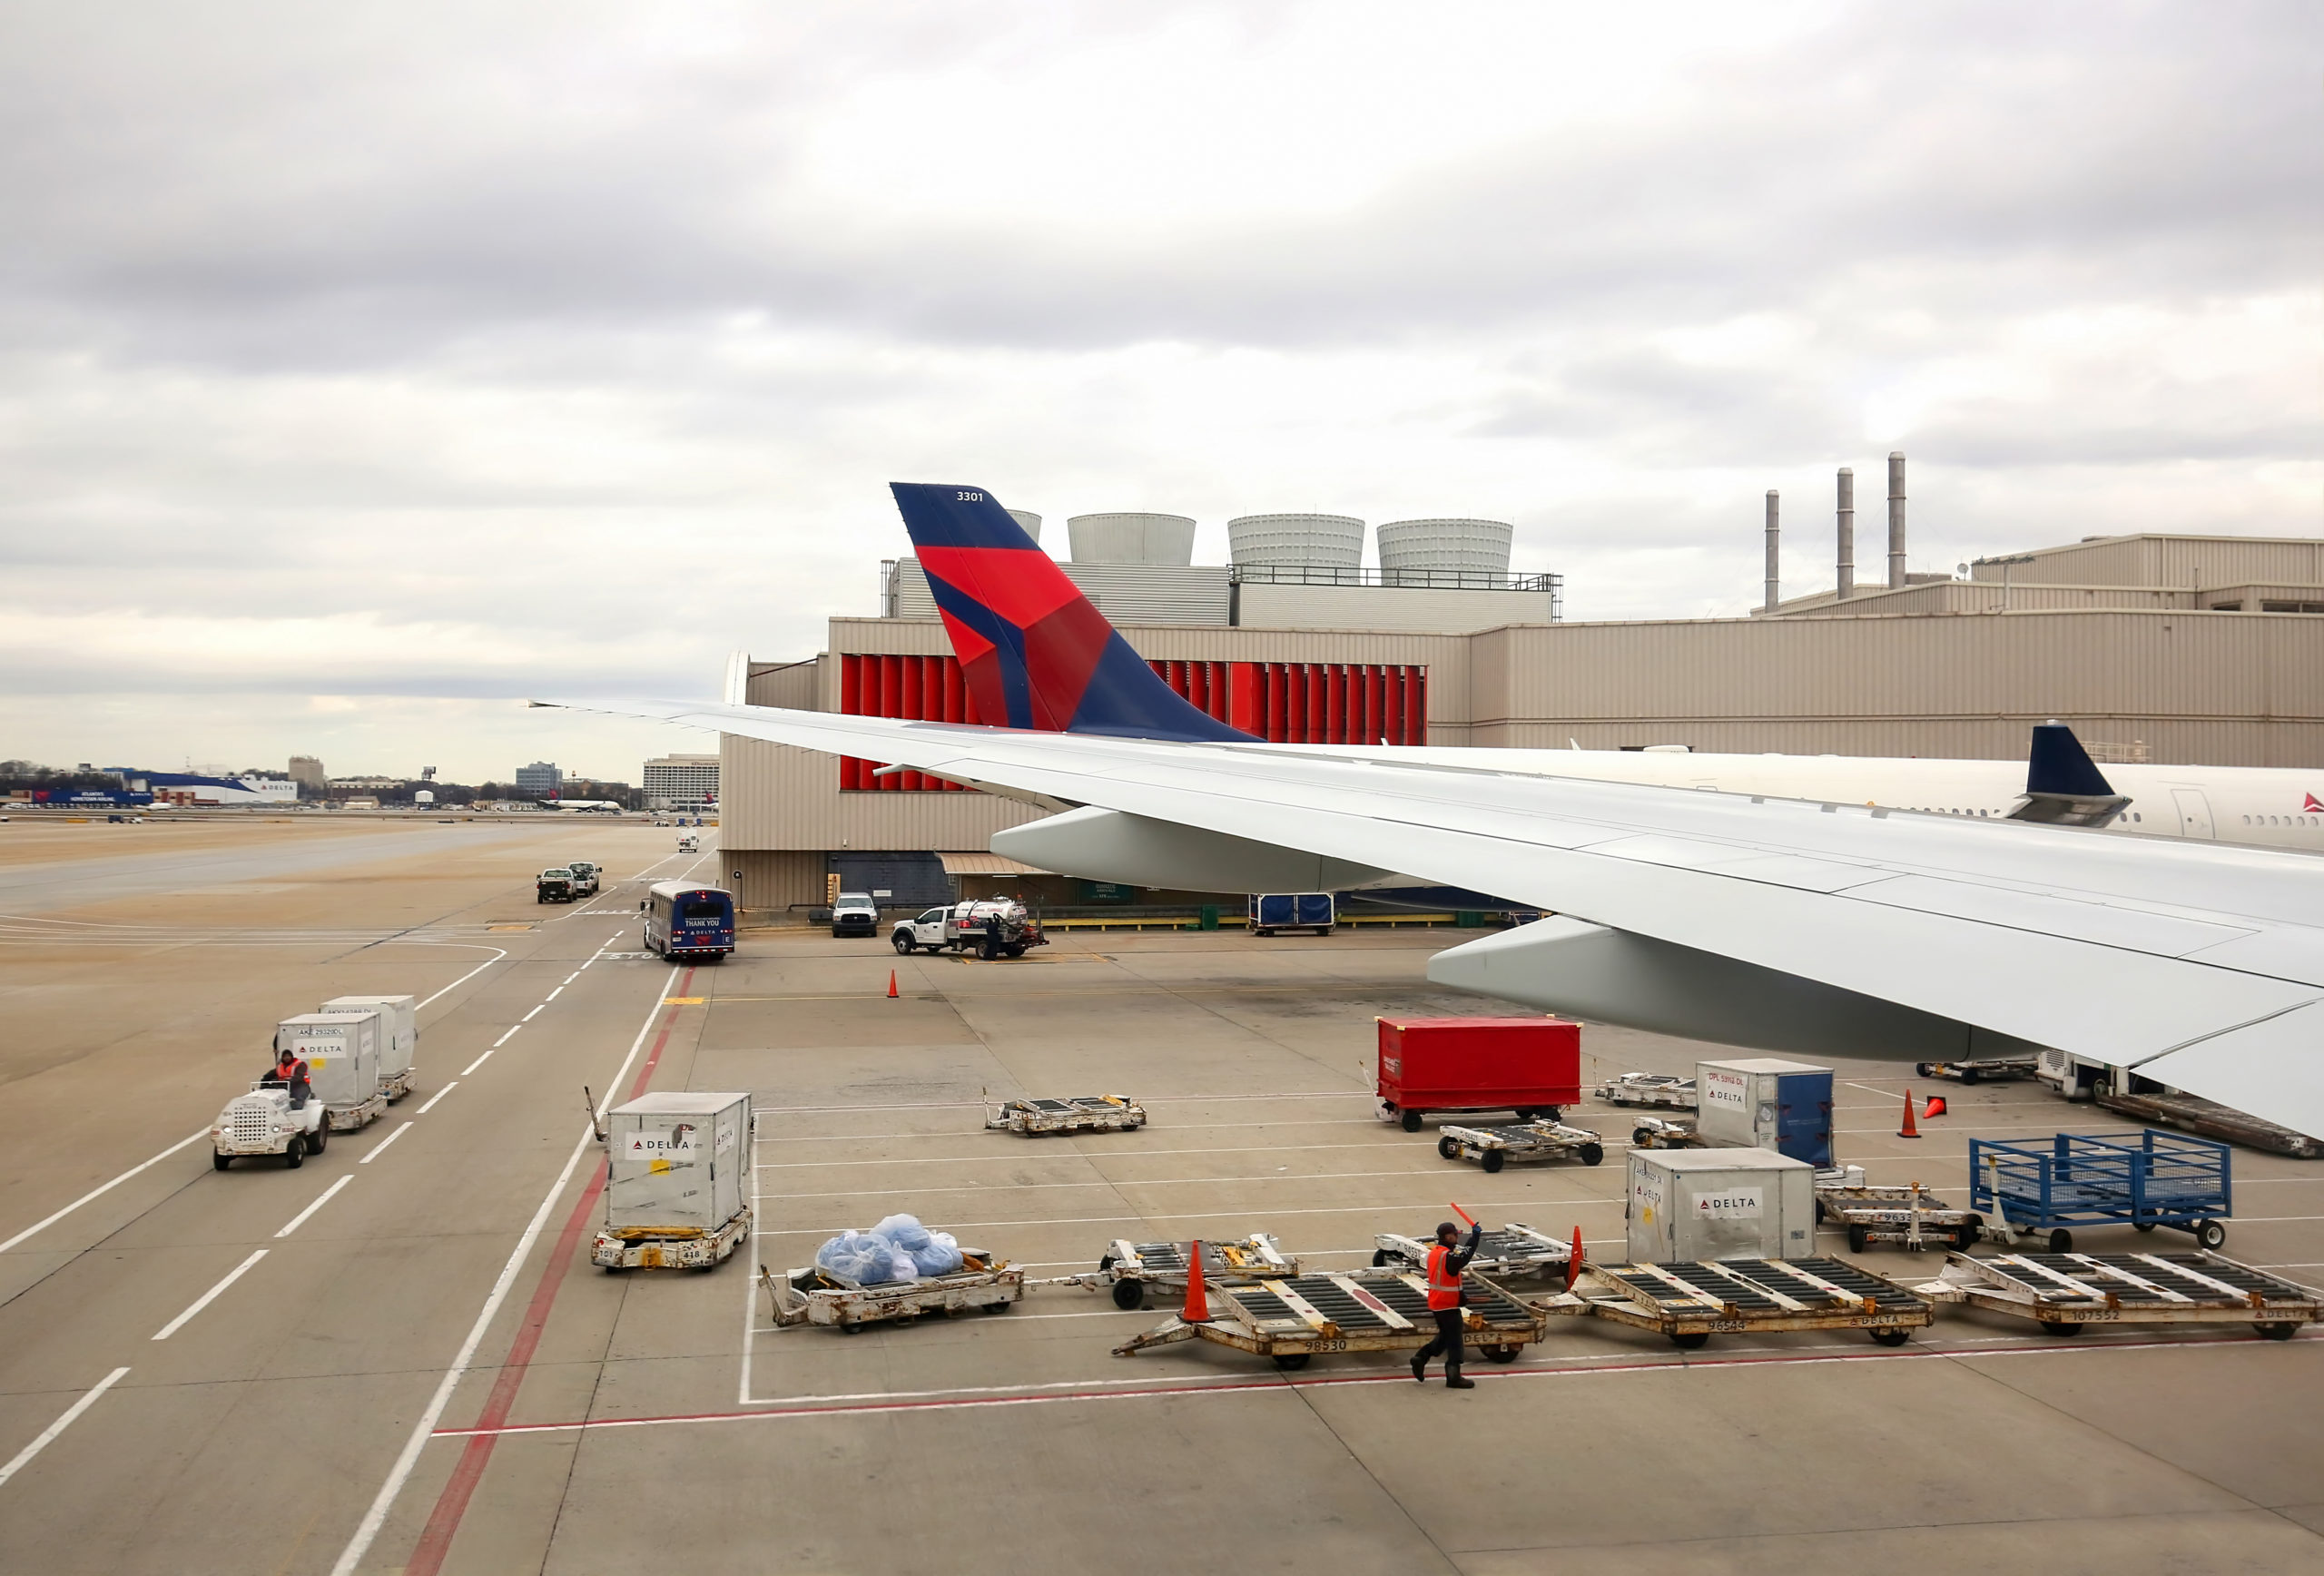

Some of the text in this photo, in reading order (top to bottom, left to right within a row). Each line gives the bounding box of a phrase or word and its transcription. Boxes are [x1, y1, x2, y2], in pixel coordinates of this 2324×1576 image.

[957, 491, 983, 502] 3301
[1718, 1091, 1742, 1103] DELTA
[1714, 1198, 1755, 1208] DELTA
[1885, 1213, 1912, 1221] 9633
[1862, 1315, 1898, 1325] DELTA
[2072, 1310, 2120, 1321] 107552
[1305, 1340, 1347, 1352] 98530
